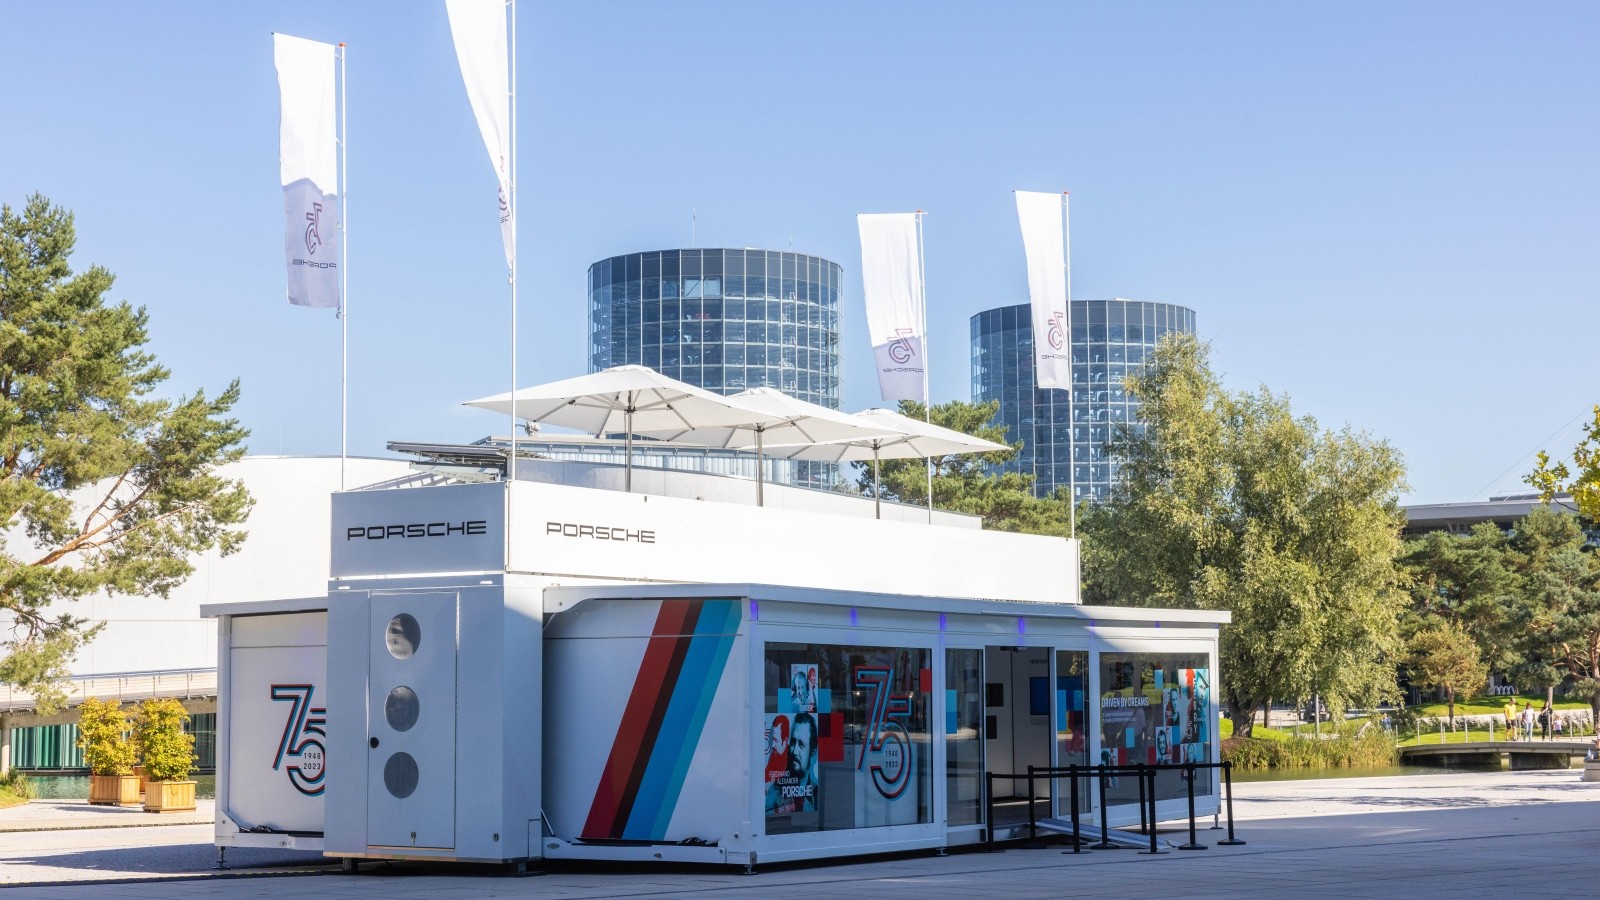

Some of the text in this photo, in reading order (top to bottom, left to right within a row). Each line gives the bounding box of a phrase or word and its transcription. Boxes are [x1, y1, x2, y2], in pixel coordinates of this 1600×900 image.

[347, 520, 487, 542] PORSCHE
[546, 521, 656, 544] PORSCHE
[1102, 697, 1120, 708] DRIVEN
[1121, 697, 1127, 707] BY
[855, 665, 911, 801] 75
[271, 684, 326, 797] 75
[304, 752, 321, 760] 1948
[303, 762, 321, 770] 2023
[885, 760, 899, 768] 2023
[781, 784, 814, 798] PORSCHE
